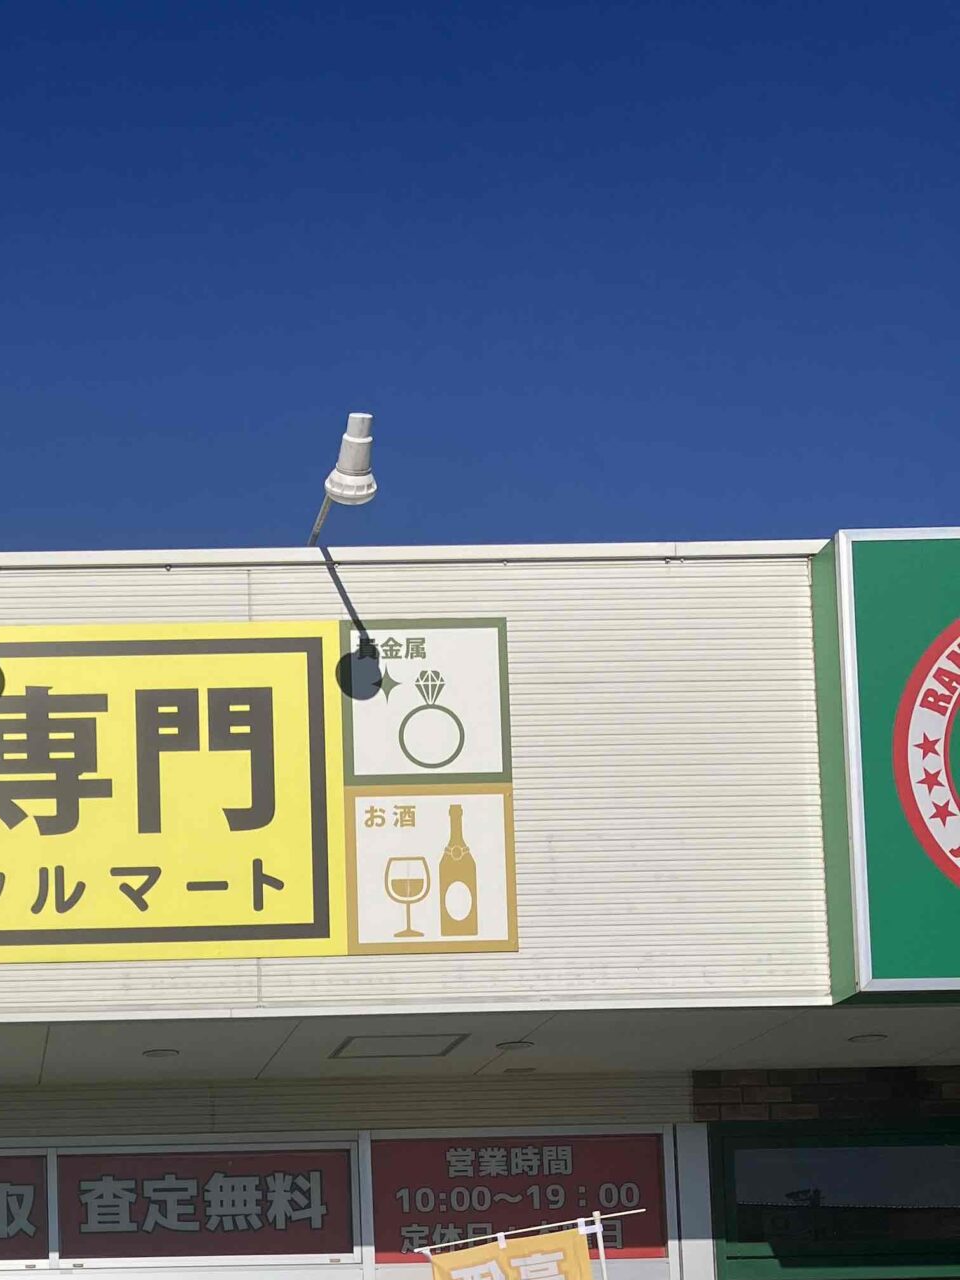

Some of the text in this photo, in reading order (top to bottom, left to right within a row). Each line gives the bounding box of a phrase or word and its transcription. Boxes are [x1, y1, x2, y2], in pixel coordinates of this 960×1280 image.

[363, 804, 417, 828] お酒
[445, 1145, 573, 1179] 営業時間
[78, 1170, 328, 1235] 査定無料
